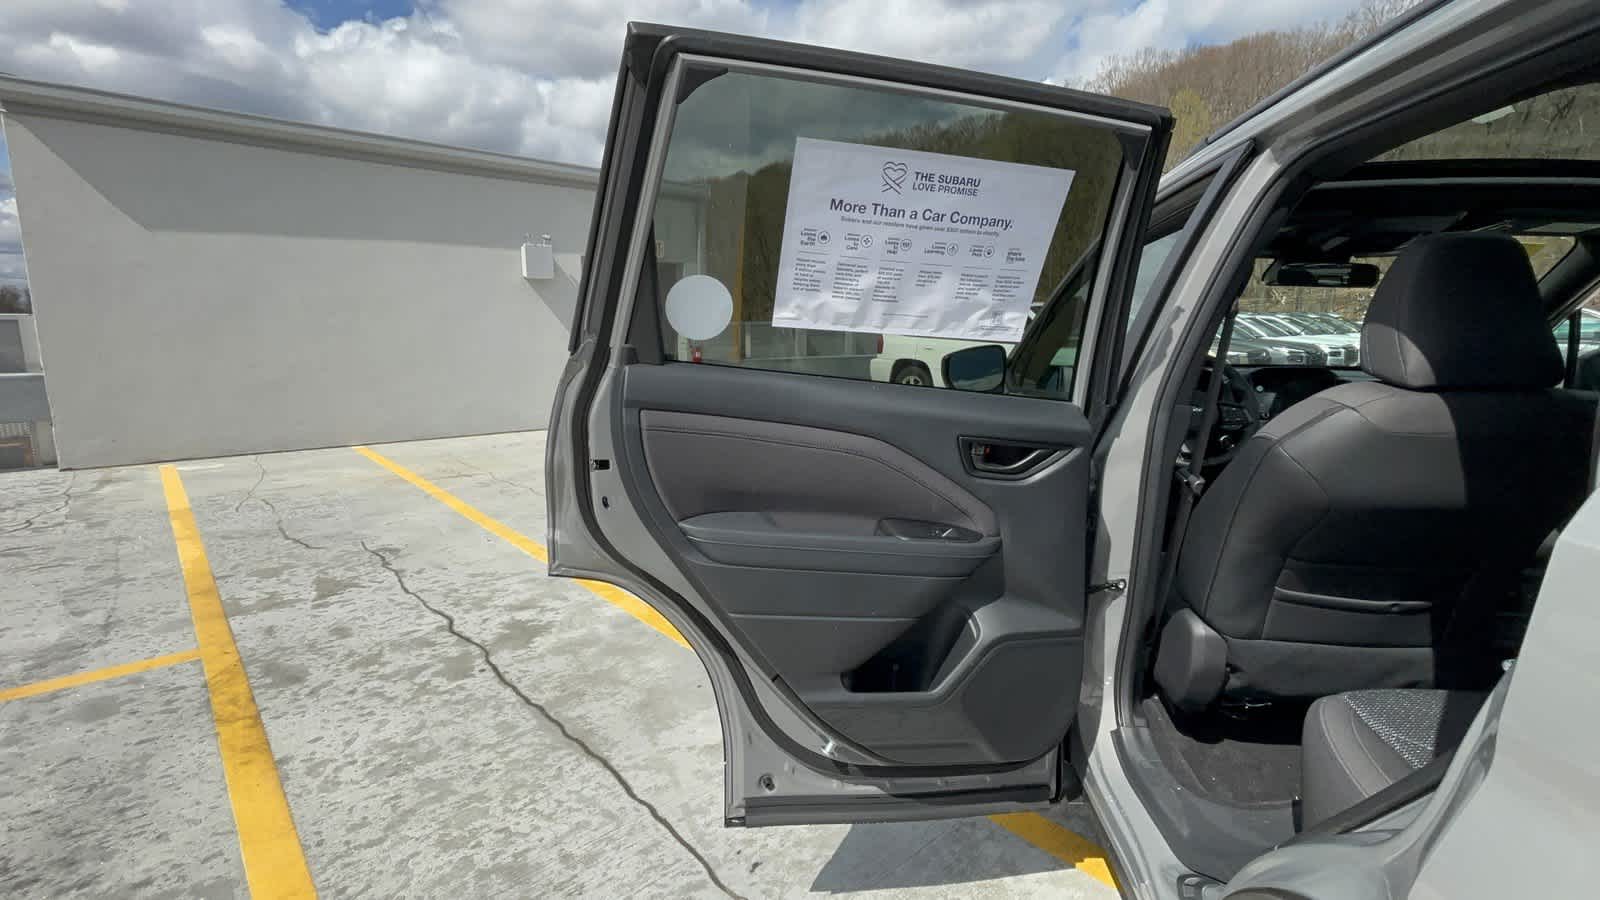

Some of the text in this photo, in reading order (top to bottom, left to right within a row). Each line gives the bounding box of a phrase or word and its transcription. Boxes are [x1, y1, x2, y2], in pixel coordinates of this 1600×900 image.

[914, 171, 981, 188] THE SUBARU
[912, 182, 979, 197] LOVE PROMISE
[829, 198, 1014, 231] More Than a Car Company.
